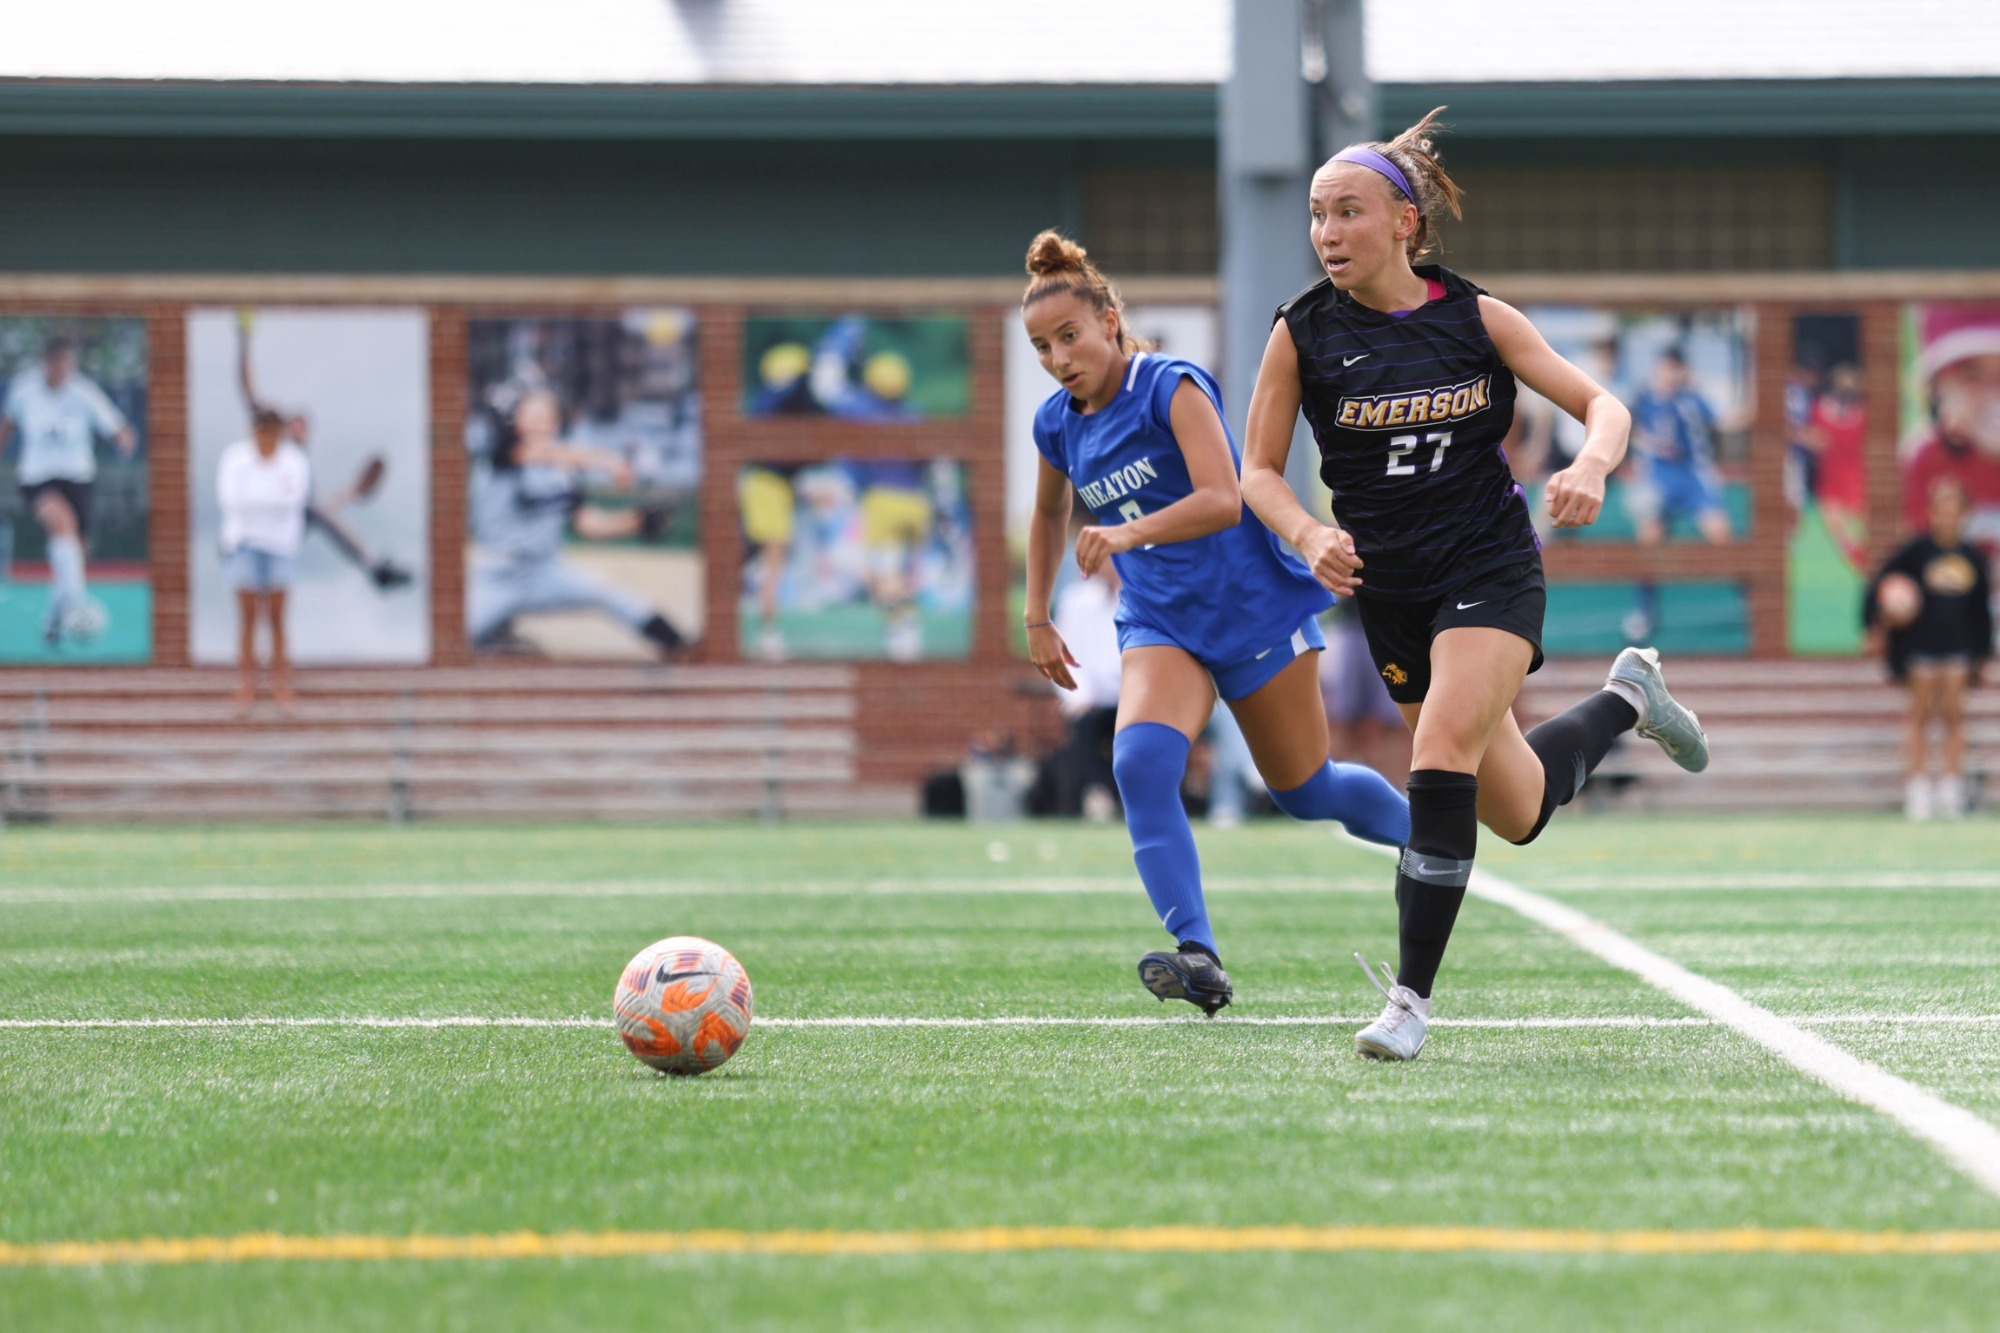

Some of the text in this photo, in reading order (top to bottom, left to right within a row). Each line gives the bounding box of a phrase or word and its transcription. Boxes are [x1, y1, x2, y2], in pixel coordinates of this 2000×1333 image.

[1337, 378, 1489, 427] EMERSON
[1386, 431, 1453, 476] 27
[1077, 456, 1158, 510] HEATON
